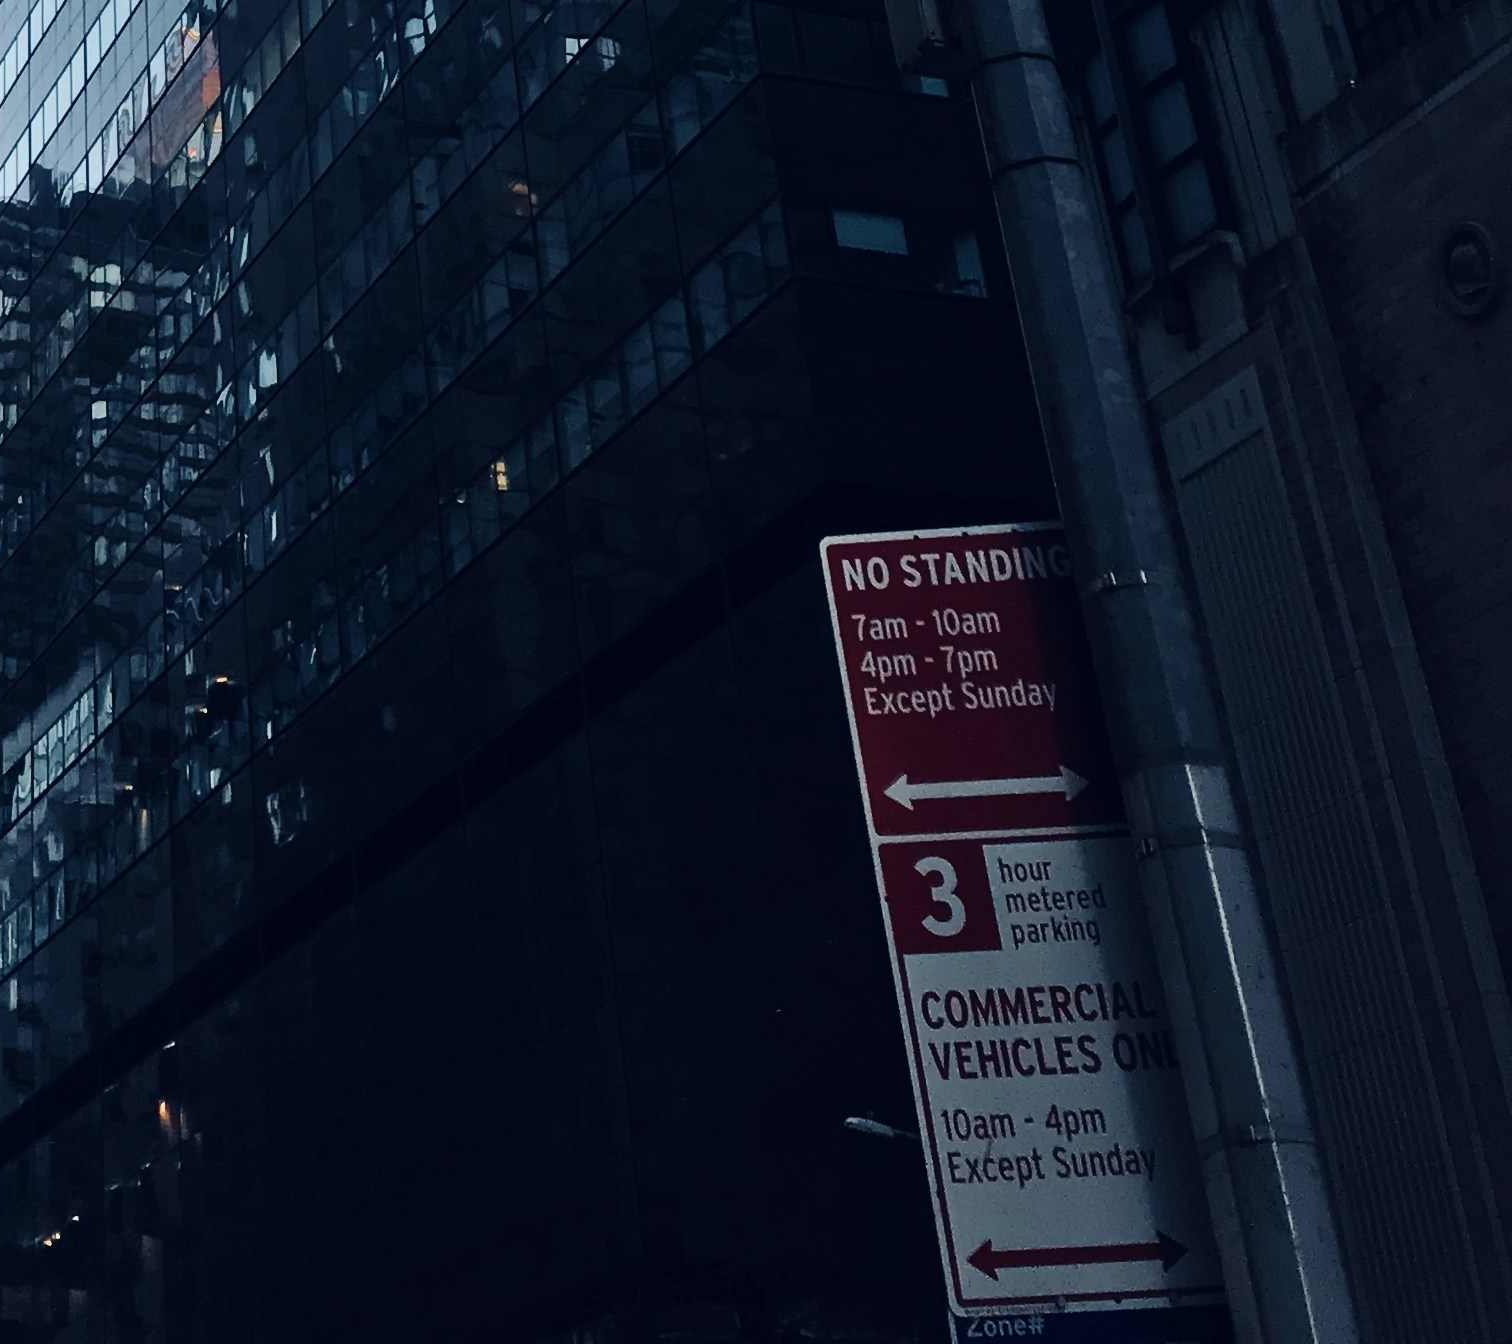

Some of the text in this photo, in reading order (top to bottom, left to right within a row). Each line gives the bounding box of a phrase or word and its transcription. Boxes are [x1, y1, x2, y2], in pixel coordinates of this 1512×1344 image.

[841, 545, 1071, 593] NO STANDING
[850, 614, 908, 642] 7am
[931, 606, 1001, 637] 10am
[860, 650, 918, 685] 4pm
[938, 645, 999, 679] 7pm
[863, 677, 1057, 719] Except Sunday
[997, 857, 1052, 885] hour
[914, 855, 967, 938] 3
[1004, 883, 1107, 913] metered
[1010, 914, 1102, 950] parking
[920, 980, 1156, 1030] COMMERCIAL
[928, 1030, 1181, 1081] VEHICLES ONL
[940, 1109, 1017, 1142] 10am
[1045, 1104, 1107, 1142] 4pm
[946, 1143, 1157, 1189] Except Sunday
[966, 1315, 1046, 1340] Zone#
